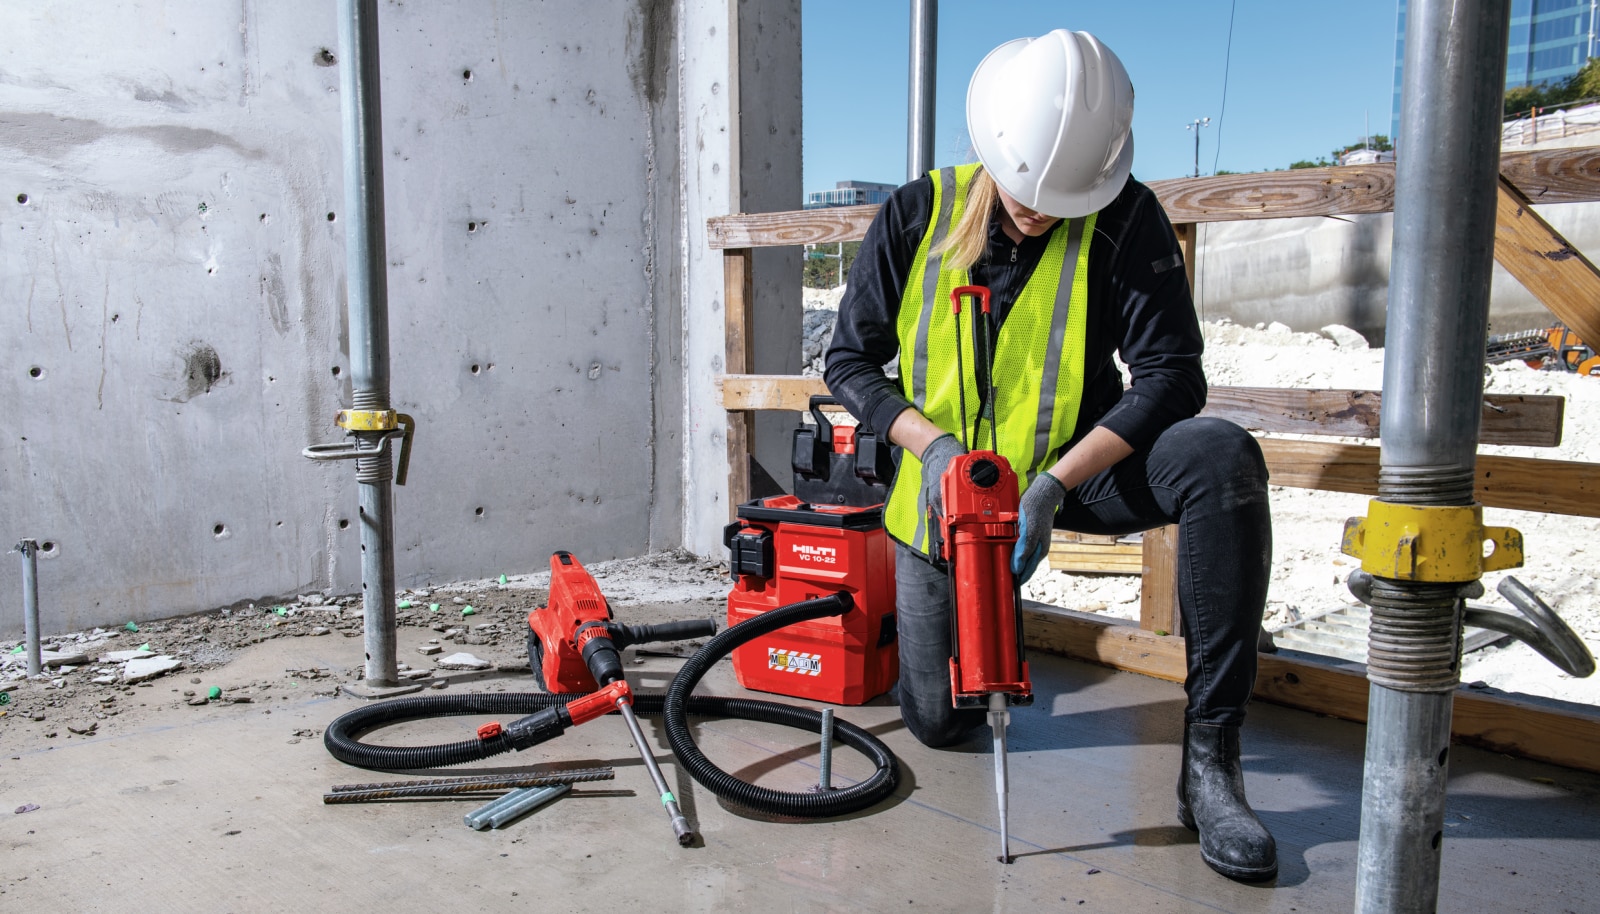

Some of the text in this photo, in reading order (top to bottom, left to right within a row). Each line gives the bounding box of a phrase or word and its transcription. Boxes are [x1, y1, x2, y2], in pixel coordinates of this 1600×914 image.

[792, 544, 836, 556] HILTI
[771, 654, 817, 670] M M
